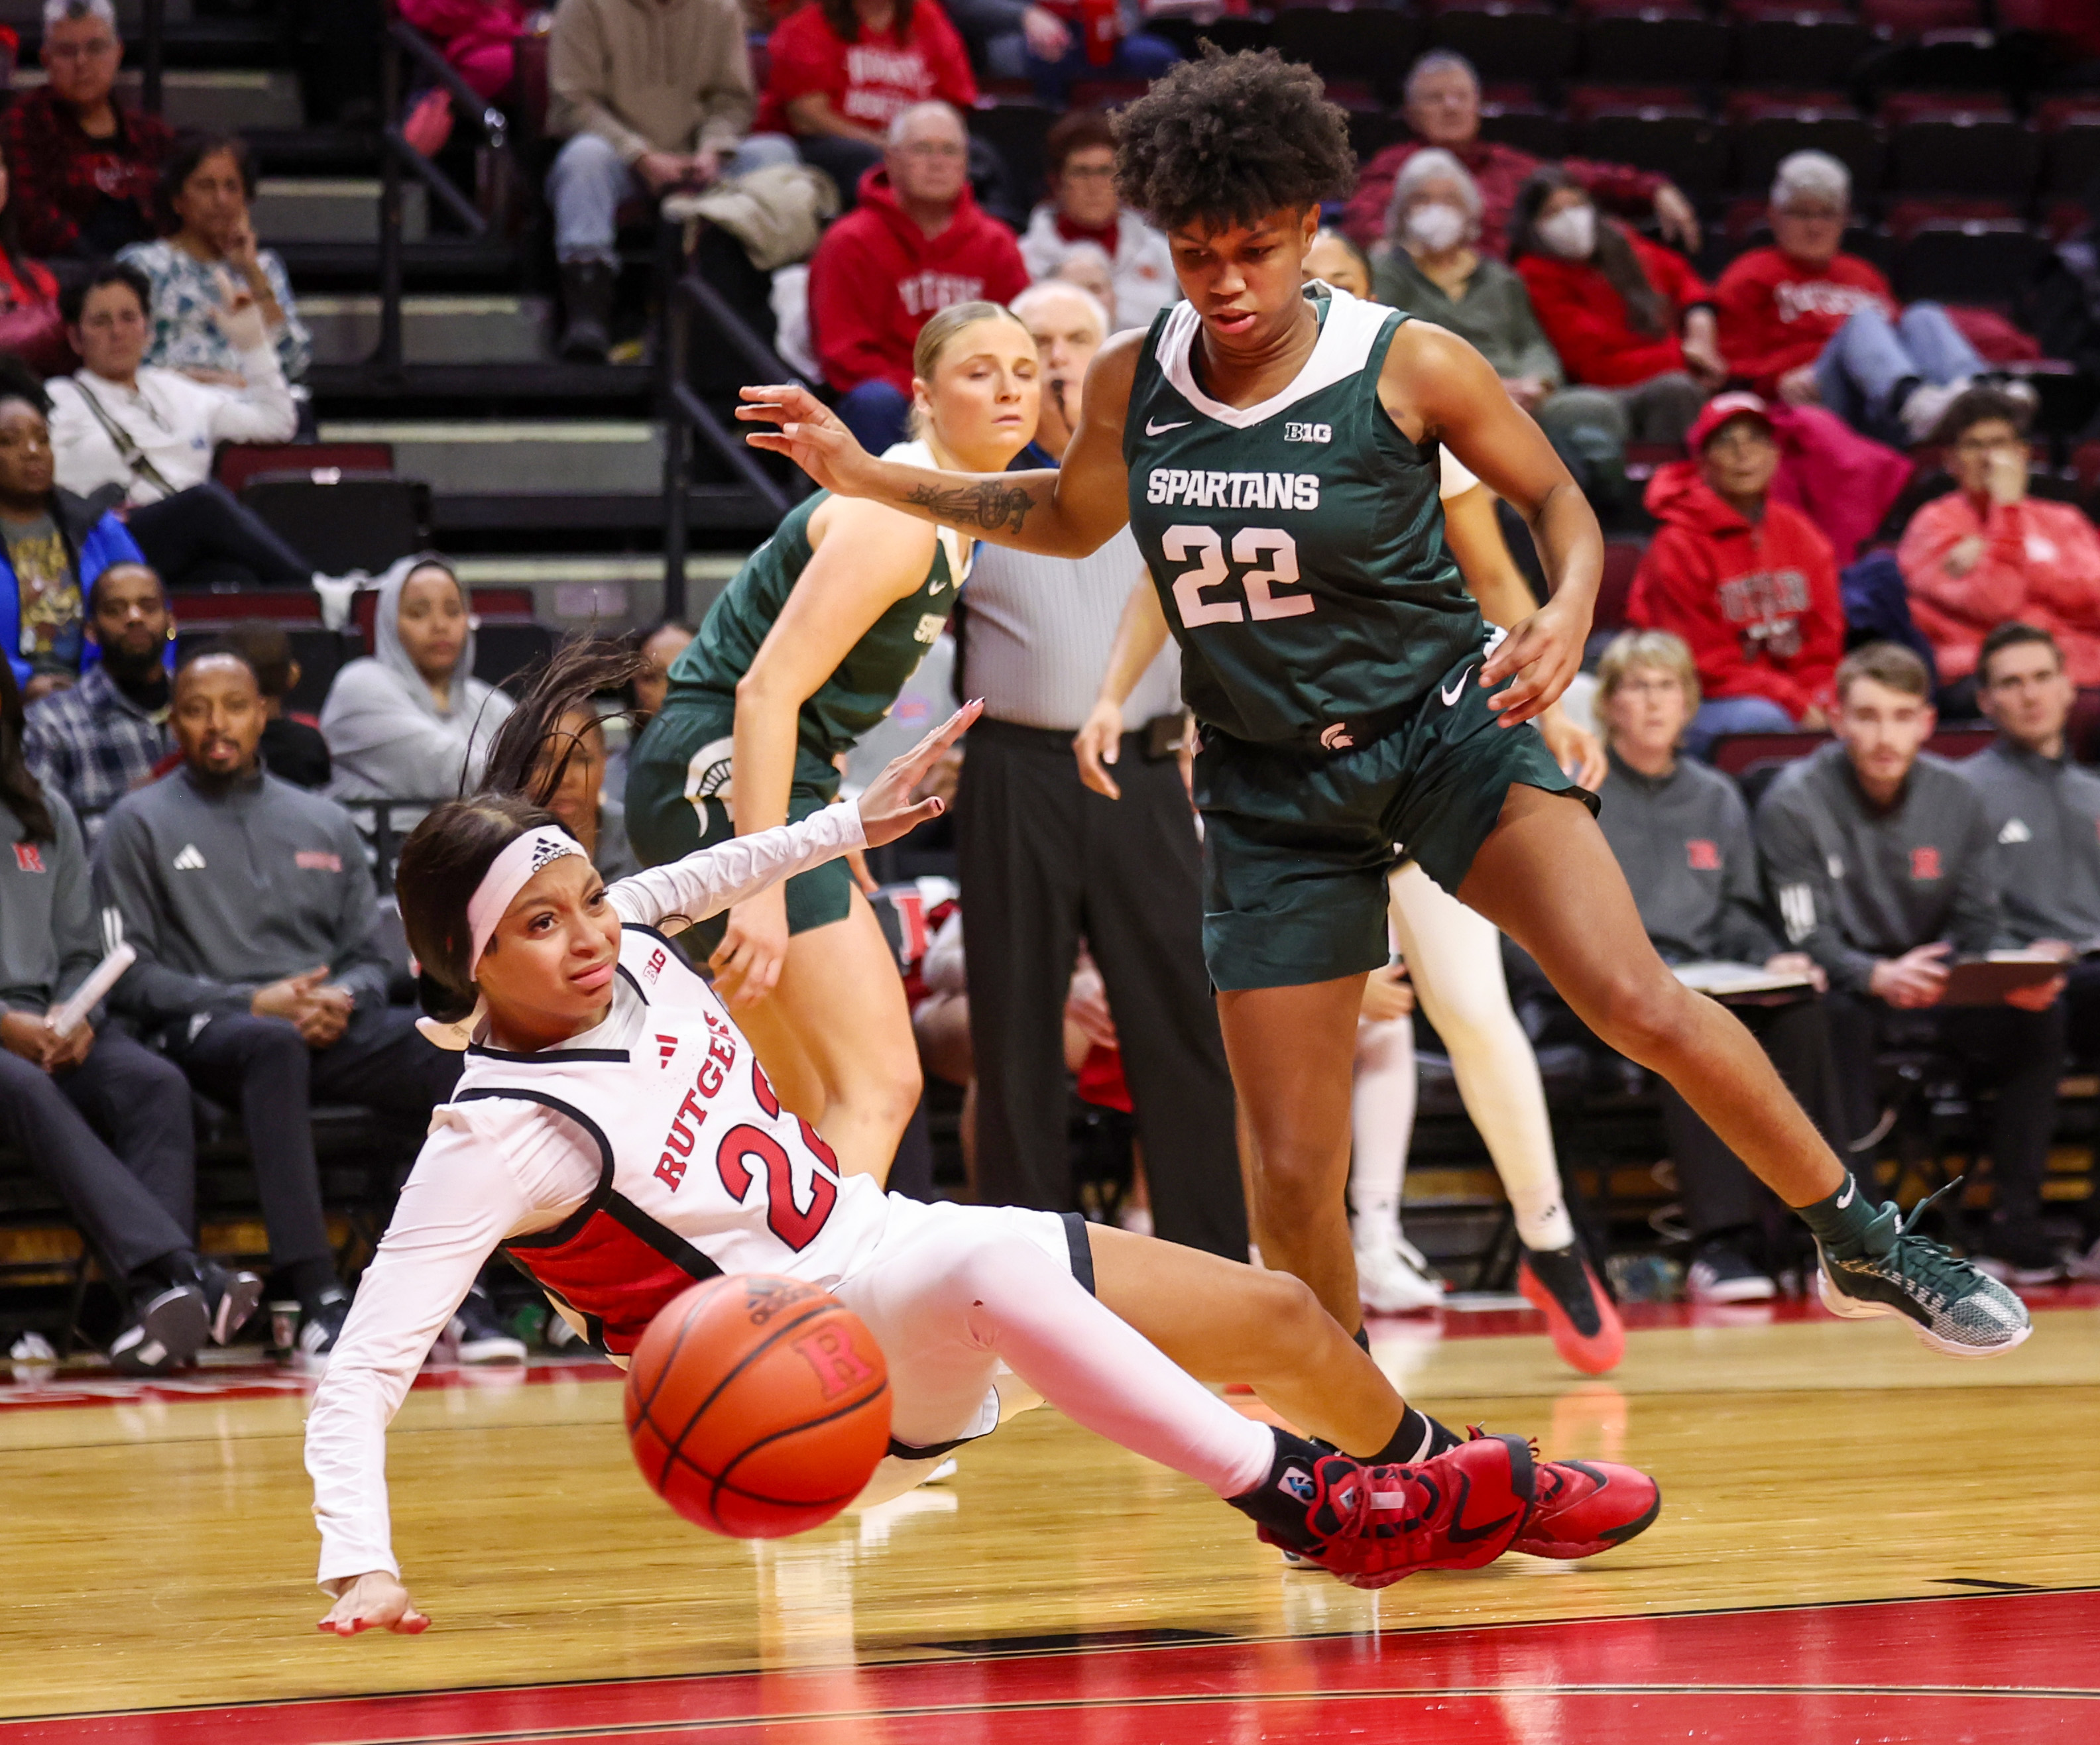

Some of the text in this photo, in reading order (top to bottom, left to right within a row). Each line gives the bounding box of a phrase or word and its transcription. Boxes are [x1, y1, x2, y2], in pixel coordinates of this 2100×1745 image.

[1146, 468, 1320, 511] SPARTANS
[1161, 524, 1316, 629] 22
[11, 842, 46, 873] R
[532, 847, 572, 872] adidas
[653, 1009, 736, 1193] RUTGE
[792, 1322, 875, 1401] R
